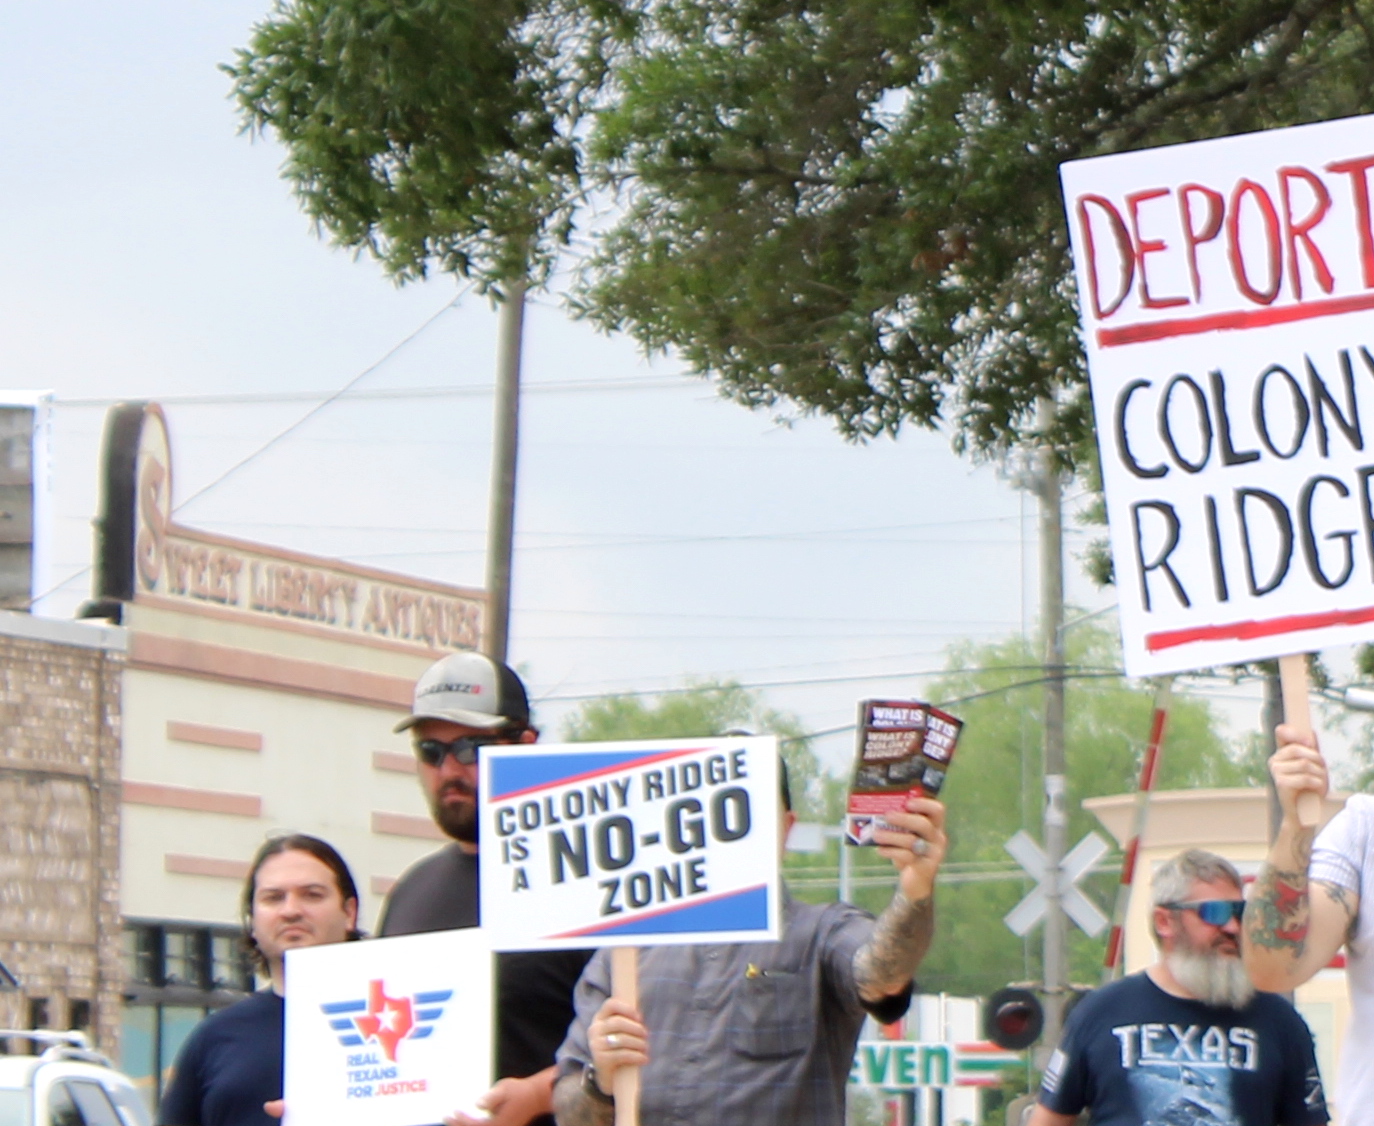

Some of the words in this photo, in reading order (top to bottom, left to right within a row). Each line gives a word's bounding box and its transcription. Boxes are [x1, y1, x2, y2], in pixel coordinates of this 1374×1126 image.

[137, 456, 242, 605] SWEET
[249, 560, 358, 628] LIBERTY
[362, 583, 481, 650] ANTIQUES
[872, 707, 908, 721] WHAT
[909, 708, 924, 721] IS
[494, 777, 631, 837] COLONY
[641, 749, 748, 801] RIDGE
[548, 785, 751, 885] NO-GO
[501, 836, 530, 865] IS
[512, 867, 530, 892] A
[598, 857, 708, 918] ZONE
[347, 1053, 380, 1067] REAL
[1111, 1023, 1258, 1070] TEXAS
[346, 1085, 373, 1099] FOR
[375, 1079, 427, 1097] JUSTICE
[347, 1066, 398, 1083] TEXANS
